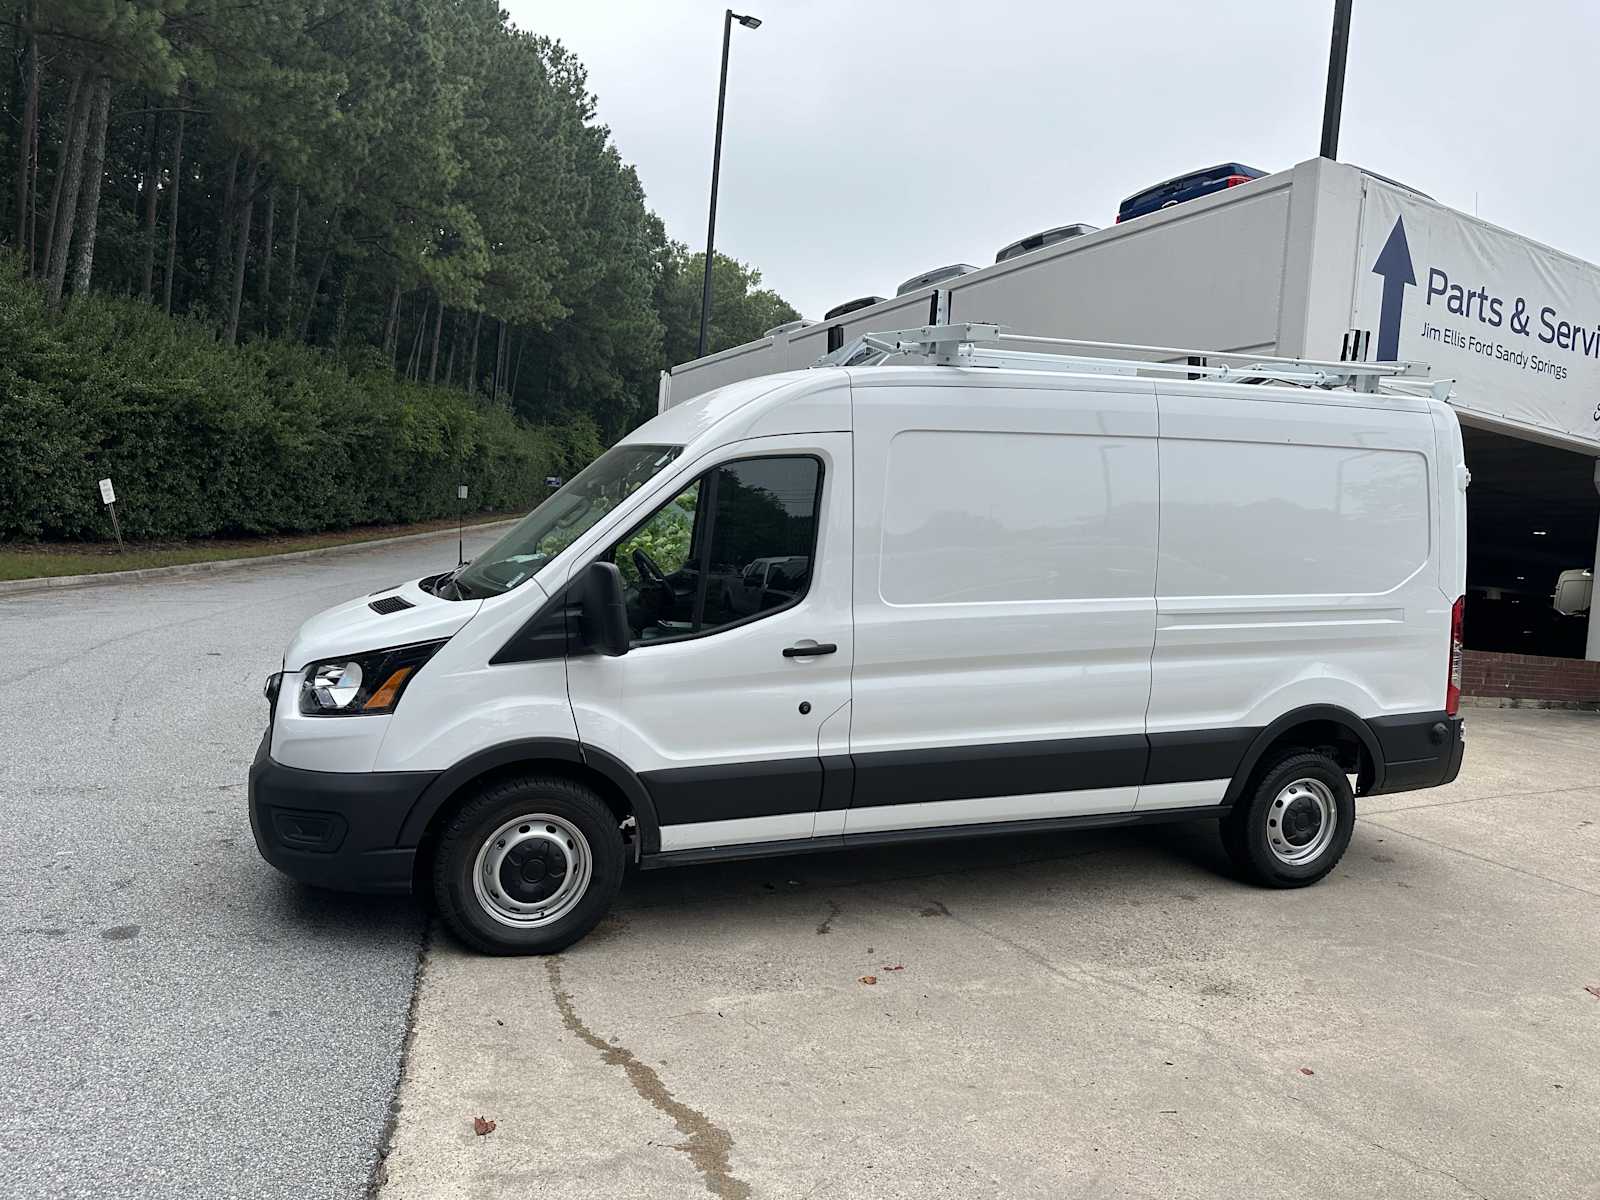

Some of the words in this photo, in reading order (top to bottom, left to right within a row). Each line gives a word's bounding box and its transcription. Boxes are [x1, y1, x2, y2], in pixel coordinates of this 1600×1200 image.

[1426, 267, 1504, 328] Parts
[1510, 297, 1530, 337] &
[1421, 321, 1441, 341] Jim
[1443, 328, 1466, 349] Ellis
[1468, 335, 1493, 357] Ford
[1495, 344, 1529, 369] Sandy
[1530, 355, 1568, 379] Springs
